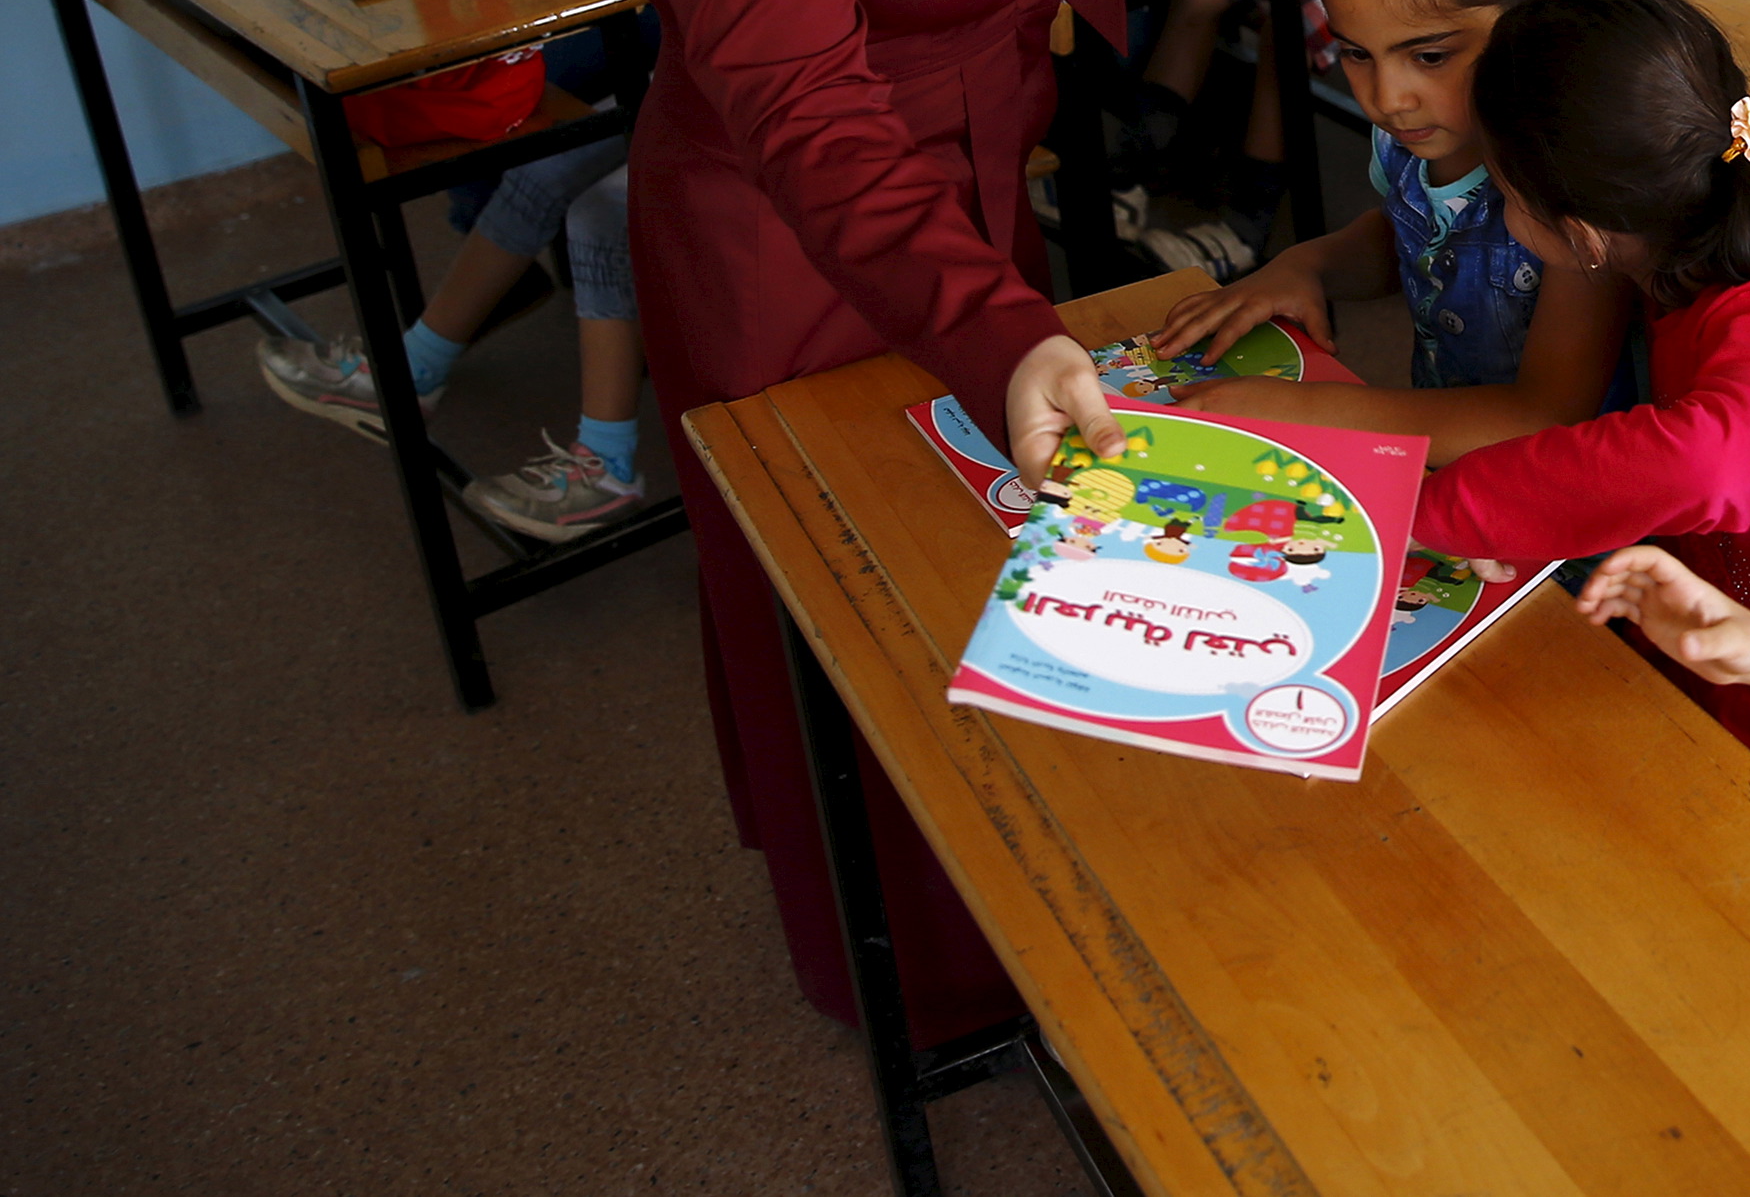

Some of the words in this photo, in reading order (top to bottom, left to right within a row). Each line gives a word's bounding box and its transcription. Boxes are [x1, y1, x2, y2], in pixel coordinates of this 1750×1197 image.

[1021, 592, 1173, 647] العربية
[1183, 629, 1297, 658] لغتي
[1103, 590, 1167, 611] الصف
[1170, 604, 1238, 621] الثاني
